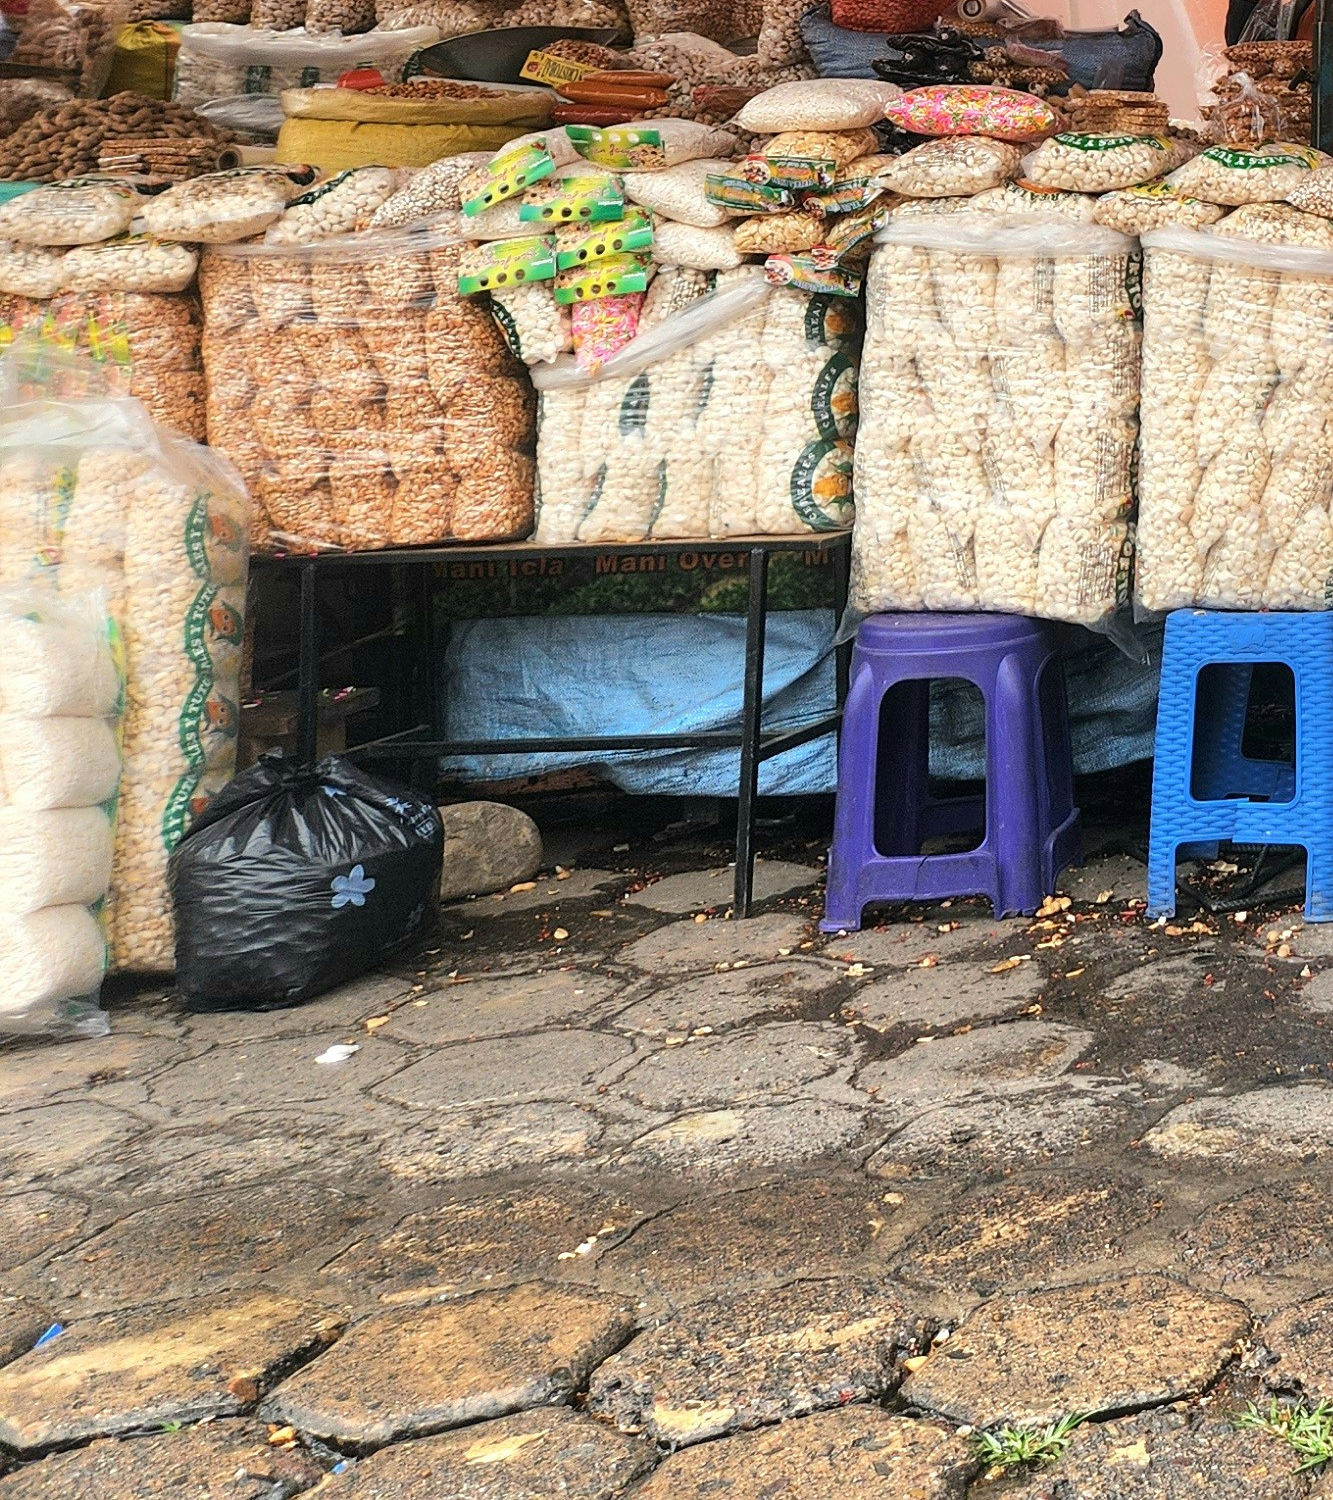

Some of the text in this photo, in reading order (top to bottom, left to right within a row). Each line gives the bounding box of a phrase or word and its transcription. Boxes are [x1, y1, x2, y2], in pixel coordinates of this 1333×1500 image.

[595, 553, 666, 574] Mani
[679, 551, 749, 570] Over
[190, 624, 201, 634] Y
[184, 716, 197, 727] Y
